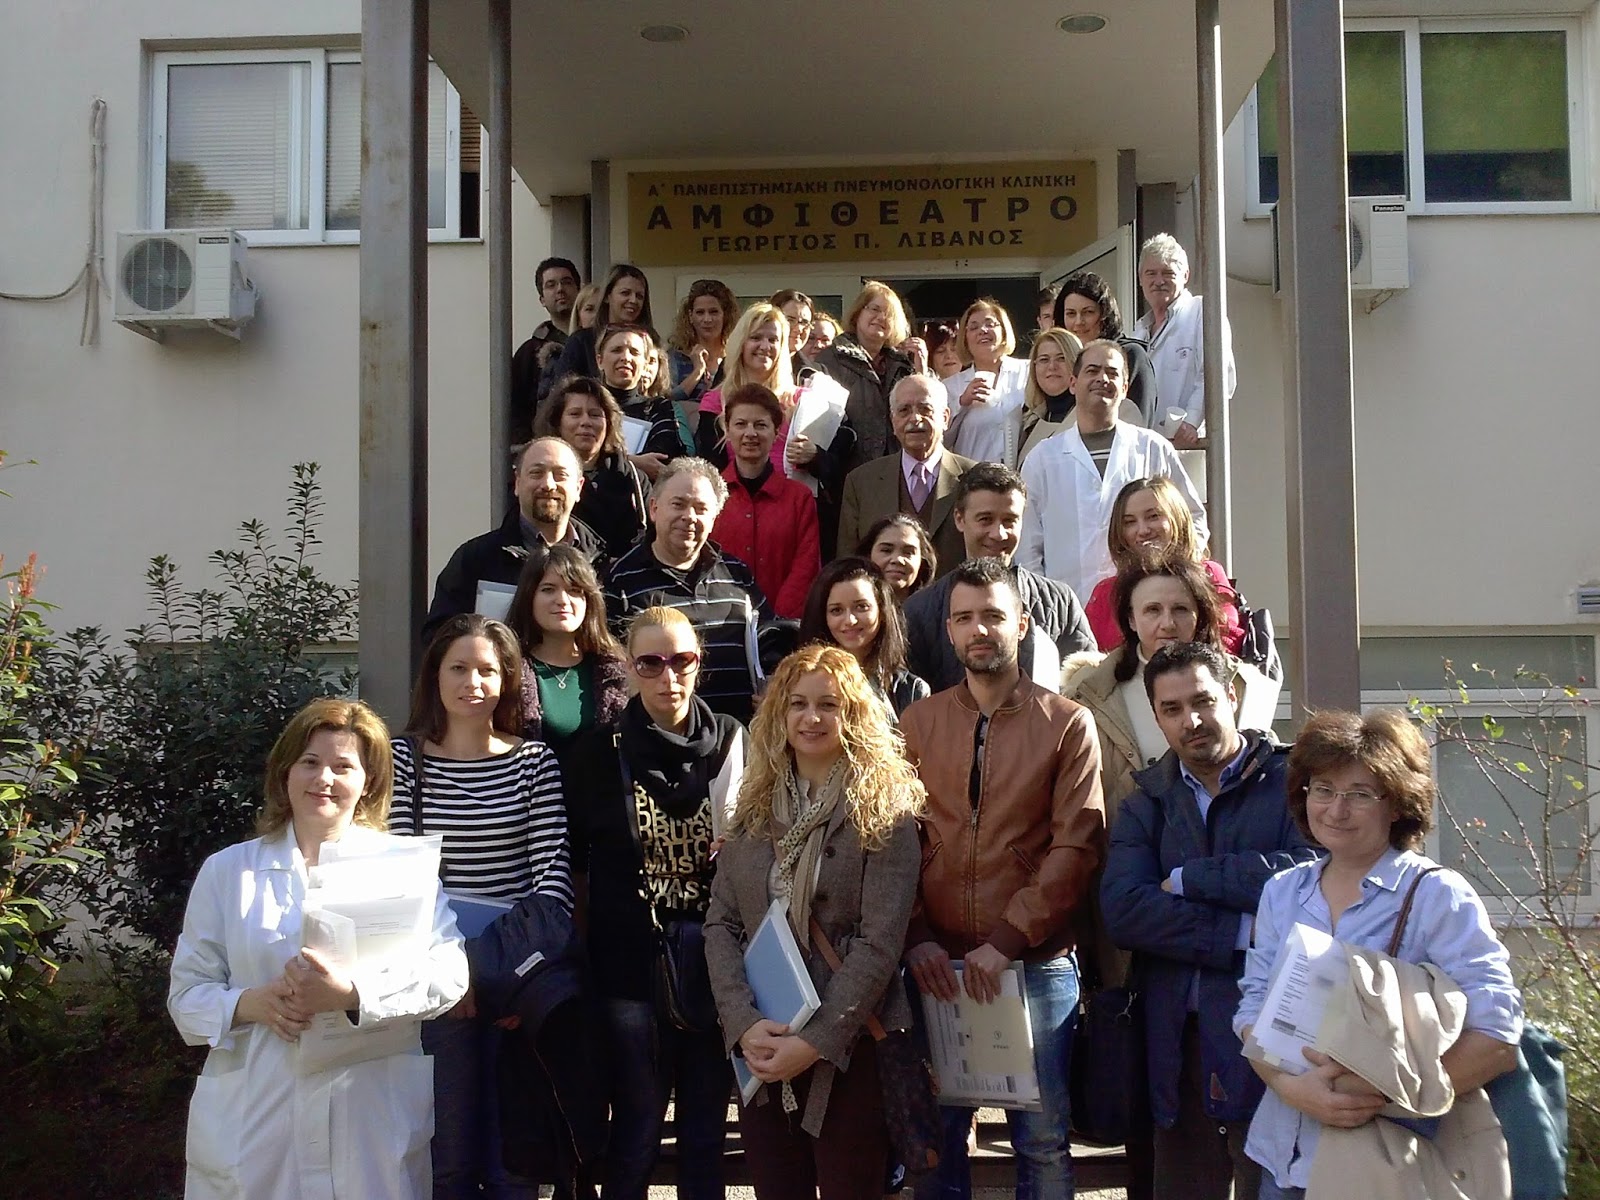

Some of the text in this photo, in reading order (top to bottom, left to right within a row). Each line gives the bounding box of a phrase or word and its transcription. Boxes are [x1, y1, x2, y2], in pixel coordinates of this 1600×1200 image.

[673, 181, 828, 197] ΠΑΝΕΠΙΣΤΗΜΙΑΚΗ
[833, 176, 995, 192] ΠΝΕΥΜΟΝΟΛΟΓΙΚΗ
[1002, 174, 1076, 188] ΚΛΙΝΙΚΗ
[646, 195, 1078, 230] ΑΜΦΙΘΕΑΤΡΟ
[702, 229, 1023, 251] ΓΕΩΡΓΙΟΣ Π. ΛΙΒΑΝΟΣ
[639, 818, 711, 845] DRUG
